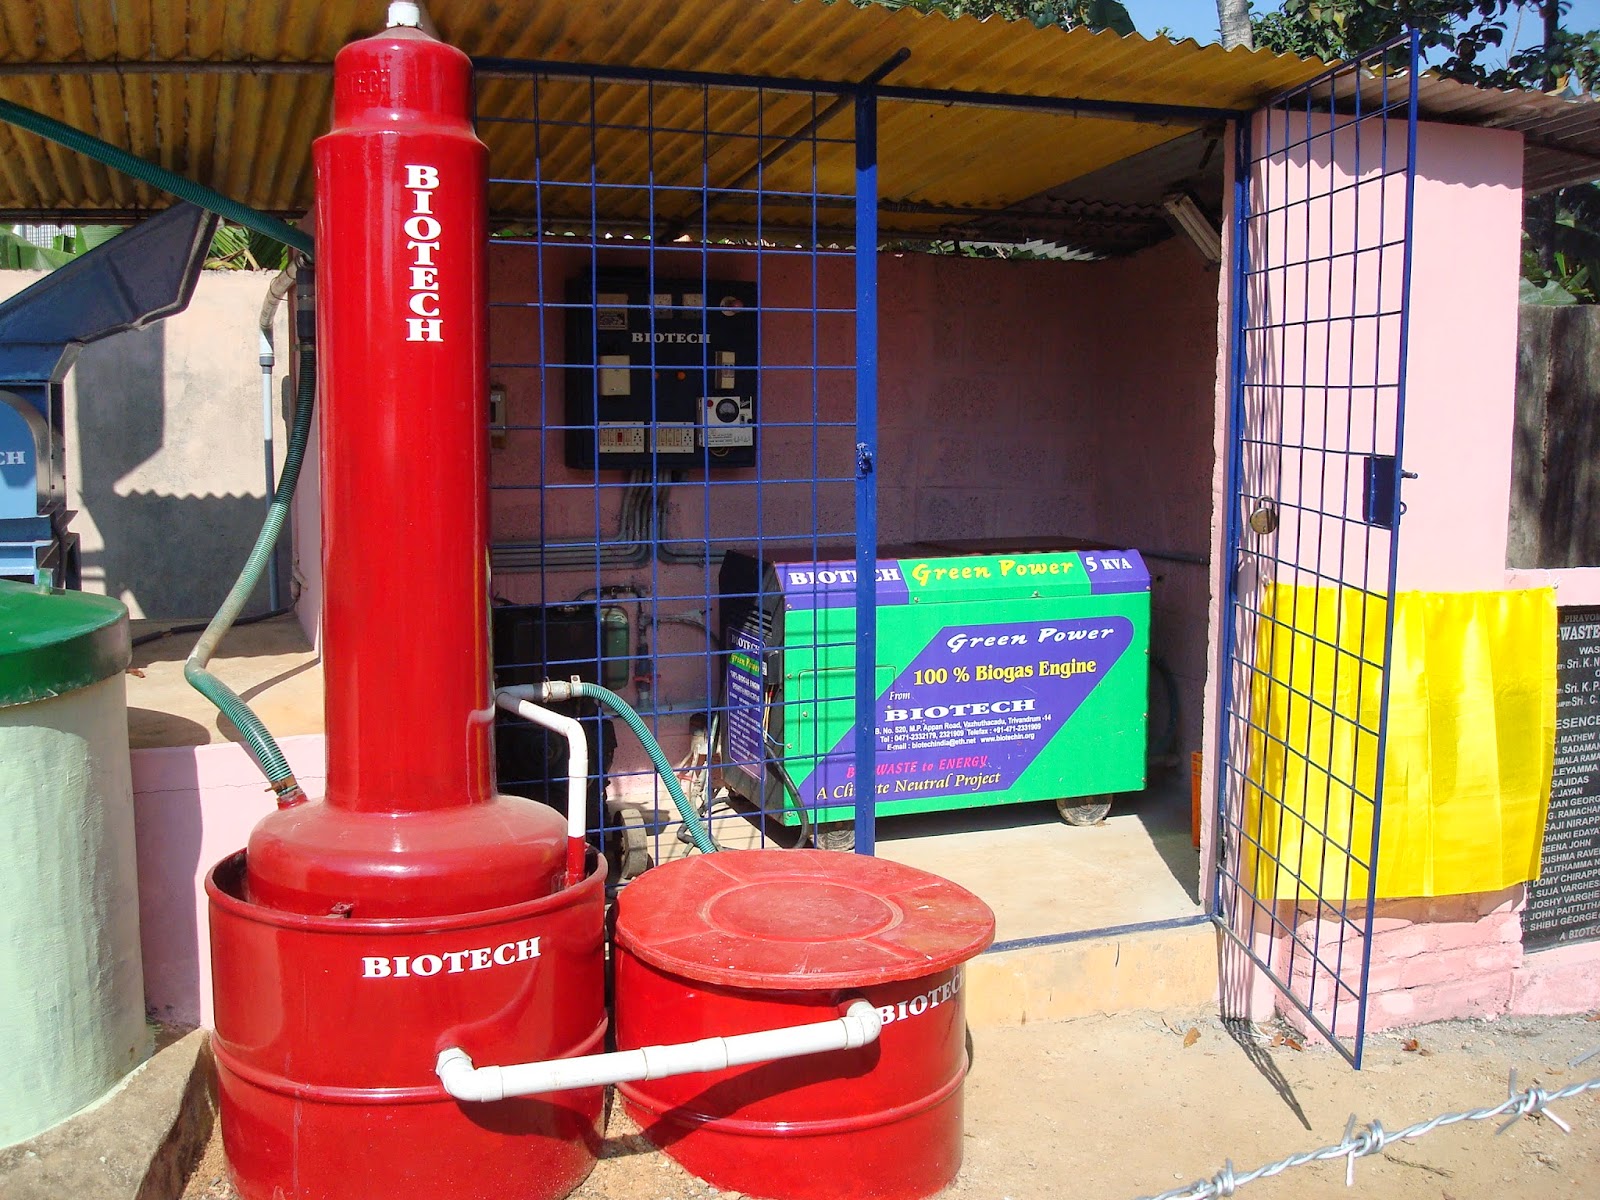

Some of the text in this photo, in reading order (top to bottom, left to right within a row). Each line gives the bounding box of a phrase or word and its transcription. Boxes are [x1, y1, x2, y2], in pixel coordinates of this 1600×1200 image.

[403, 164, 444, 342] BIOTECH
[631, 332, 711, 344] BIOTECH
[1085, 557, 1133, 572] 5 KVA
[788, 568, 901, 585] BIOTH
[911, 559, 1074, 586] Green Power
[1560, 624, 1600, 641] WASTE
[946, 627, 1114, 653] Green Power
[1566, 658, 1582, 669] Sri.
[1583, 657, 1592, 668] K.
[913, 657, 1097, 685] 100 % Biogas Engine
[1564, 683, 1580, 694] Sri.
[1581, 681, 1591, 692] K.
[889, 691, 911, 700] From
[1571, 696, 1587, 707] Sri.
[884, 699, 1036, 722] BIOTECH
[923, 723, 943, 732] Appan
[1008, 716, 1041, 725] Trivandrum
[1560, 732, 1596, 744] MATHEW
[876, 755, 988, 776] WASTE to ENERGY
[1552, 764, 1599, 776] LEYAMMA
[816, 772, 1001, 800] A Clite Neutral Project
[1552, 776, 1590, 788] SAJIDAS
[1558, 787, 1583, 797] JAYAN
[1573, 827, 1600, 838] EDAYA
[1569, 839, 1591, 849] JOHN
[1577, 848, 1600, 859] RAVE
[1540, 859, 1593, 875] ALITHAMMA
[1532, 876, 1559, 887] DOMY
[1536, 887, 1559, 898] SUJA
[1531, 897, 1562, 909] JOSHY
[1530, 909, 1555, 921] JOHN
[1530, 919, 1558, 931] SHIBU
[1560, 912, 1598, 925] GEORGE
[361, 936, 542, 978] BIOTECH
[876, 970, 966, 1026] BIOTECH
